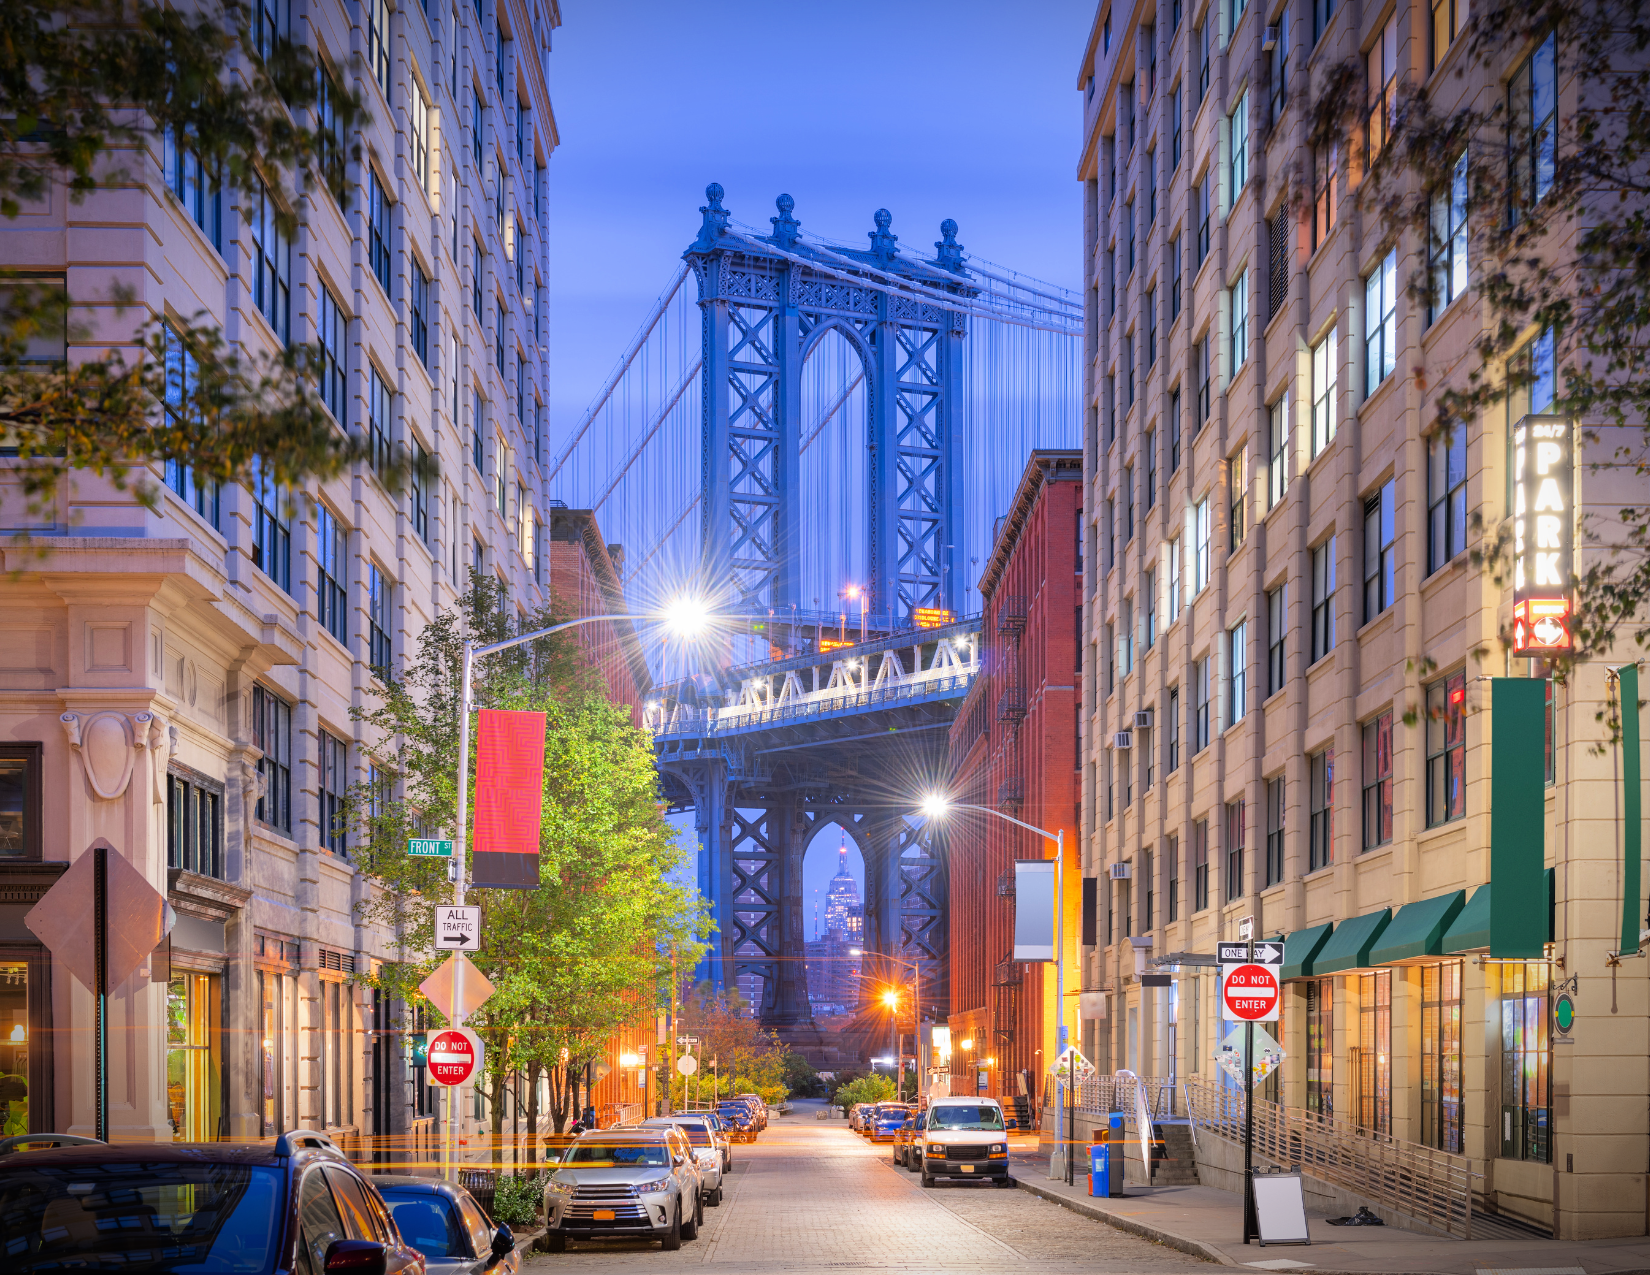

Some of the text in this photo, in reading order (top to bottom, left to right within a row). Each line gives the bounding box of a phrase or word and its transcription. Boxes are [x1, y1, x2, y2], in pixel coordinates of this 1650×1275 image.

[1532, 424, 1566, 438] 24/7
[1534, 442, 1565, 585] PARK
[410, 841, 440, 854] FRONT
[447, 909, 468, 920] ALL
[442, 922, 473, 931] TRAFFIC
[1224, 948, 1243, 958] ONE
[1232, 975, 1271, 985] DO NOT
[1235, 1000, 1267, 1009] ENTER
[434, 1041, 468, 1051] DO NOT
[437, 1065, 464, 1075] ENTER
